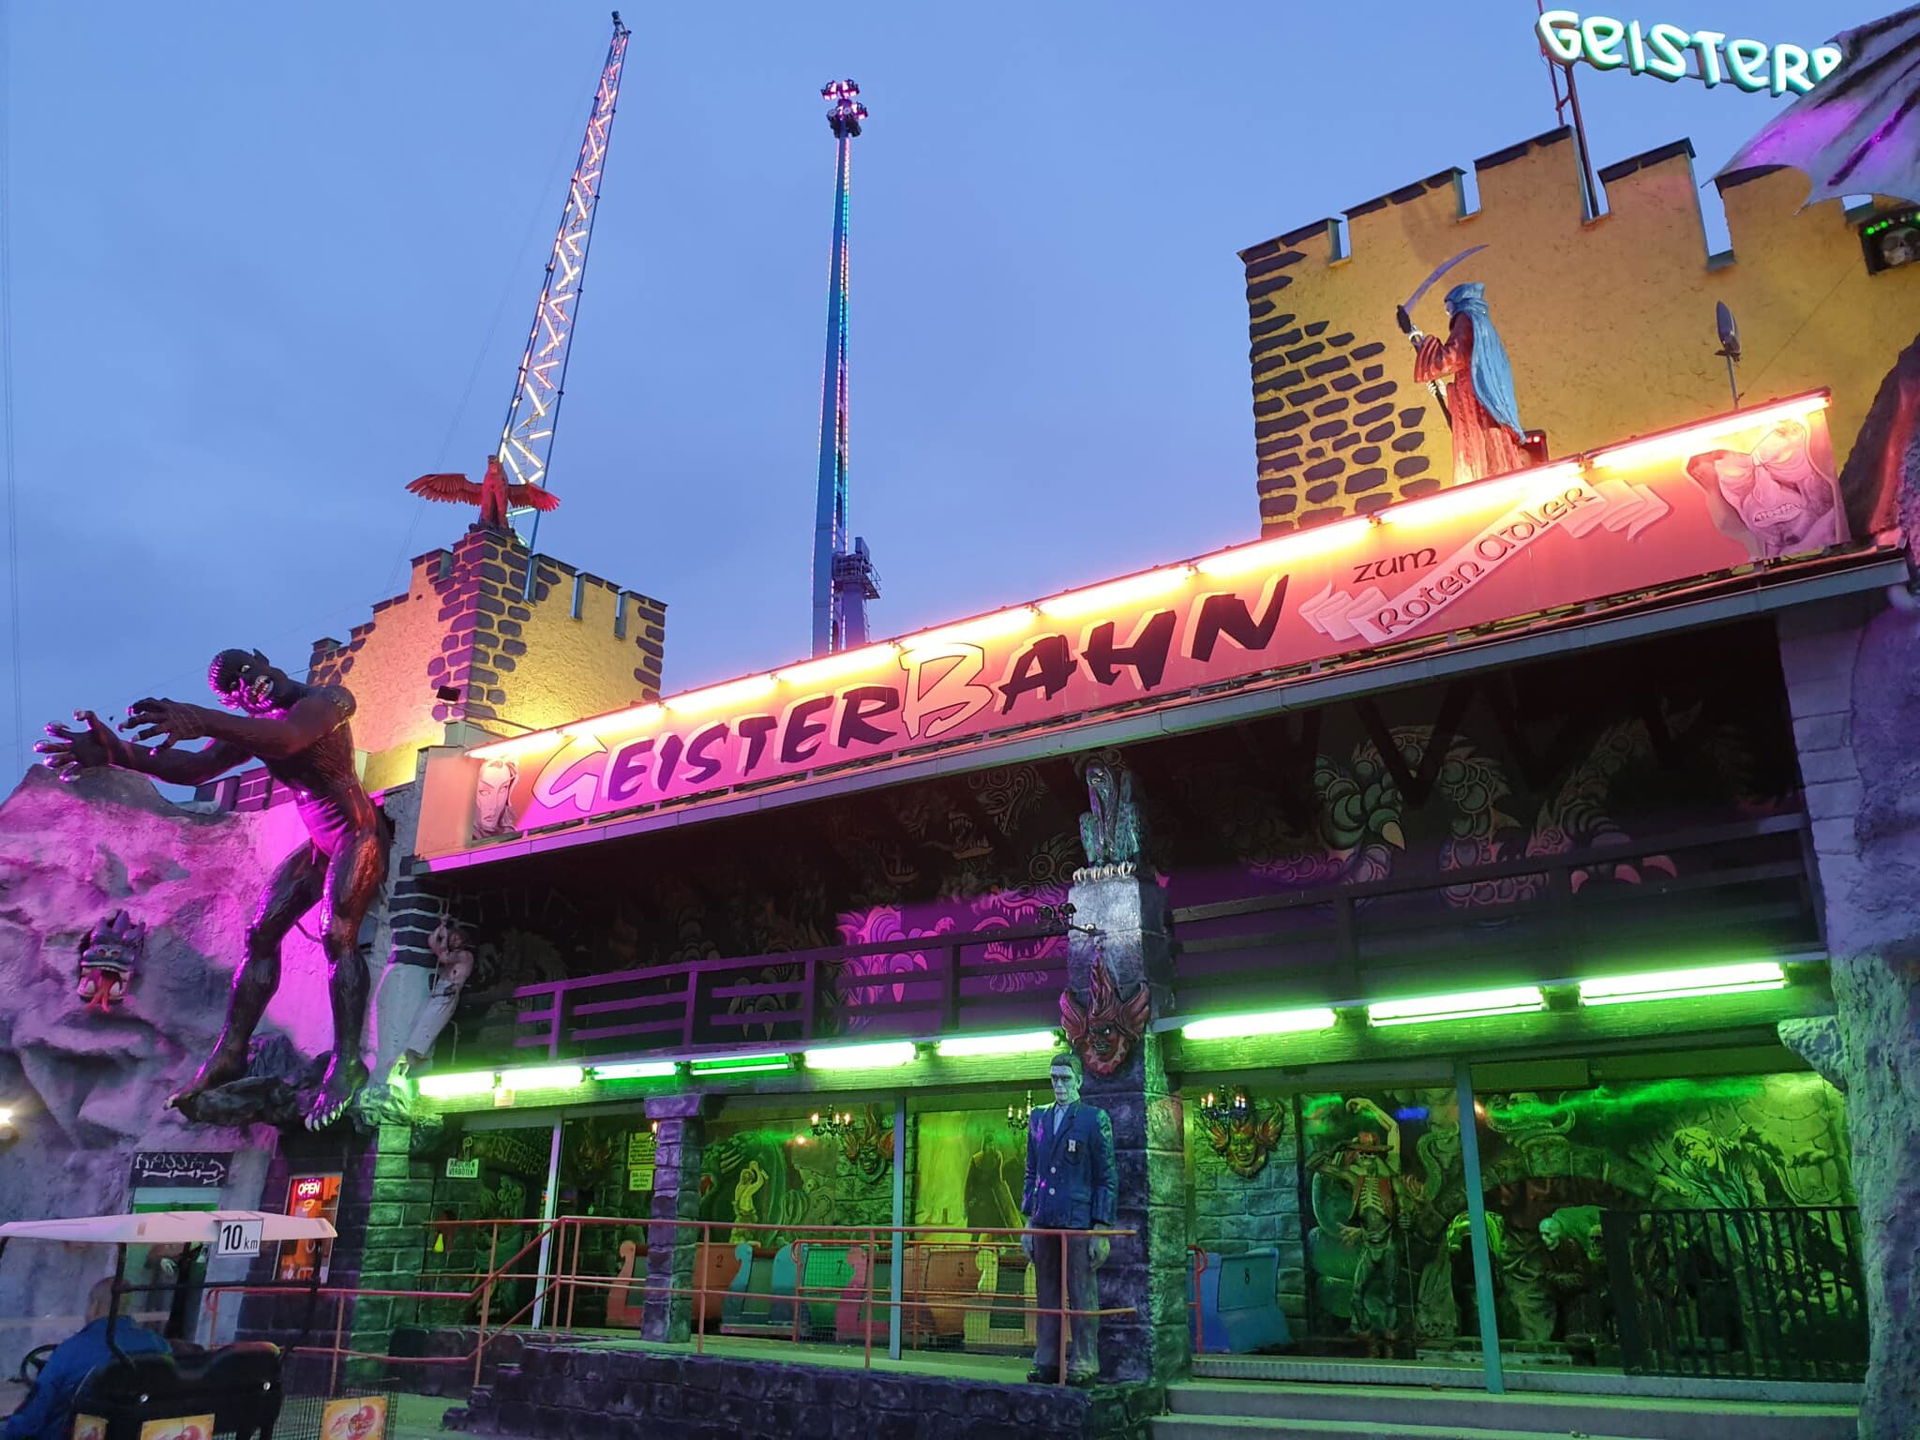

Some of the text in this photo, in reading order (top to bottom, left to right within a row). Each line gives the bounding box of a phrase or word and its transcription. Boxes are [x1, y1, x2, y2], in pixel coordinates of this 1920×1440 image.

[298, 1182, 321, 1196] OPEN
[223, 1224, 259, 1250] 10 km
[836, 1260, 844, 1275] 7
